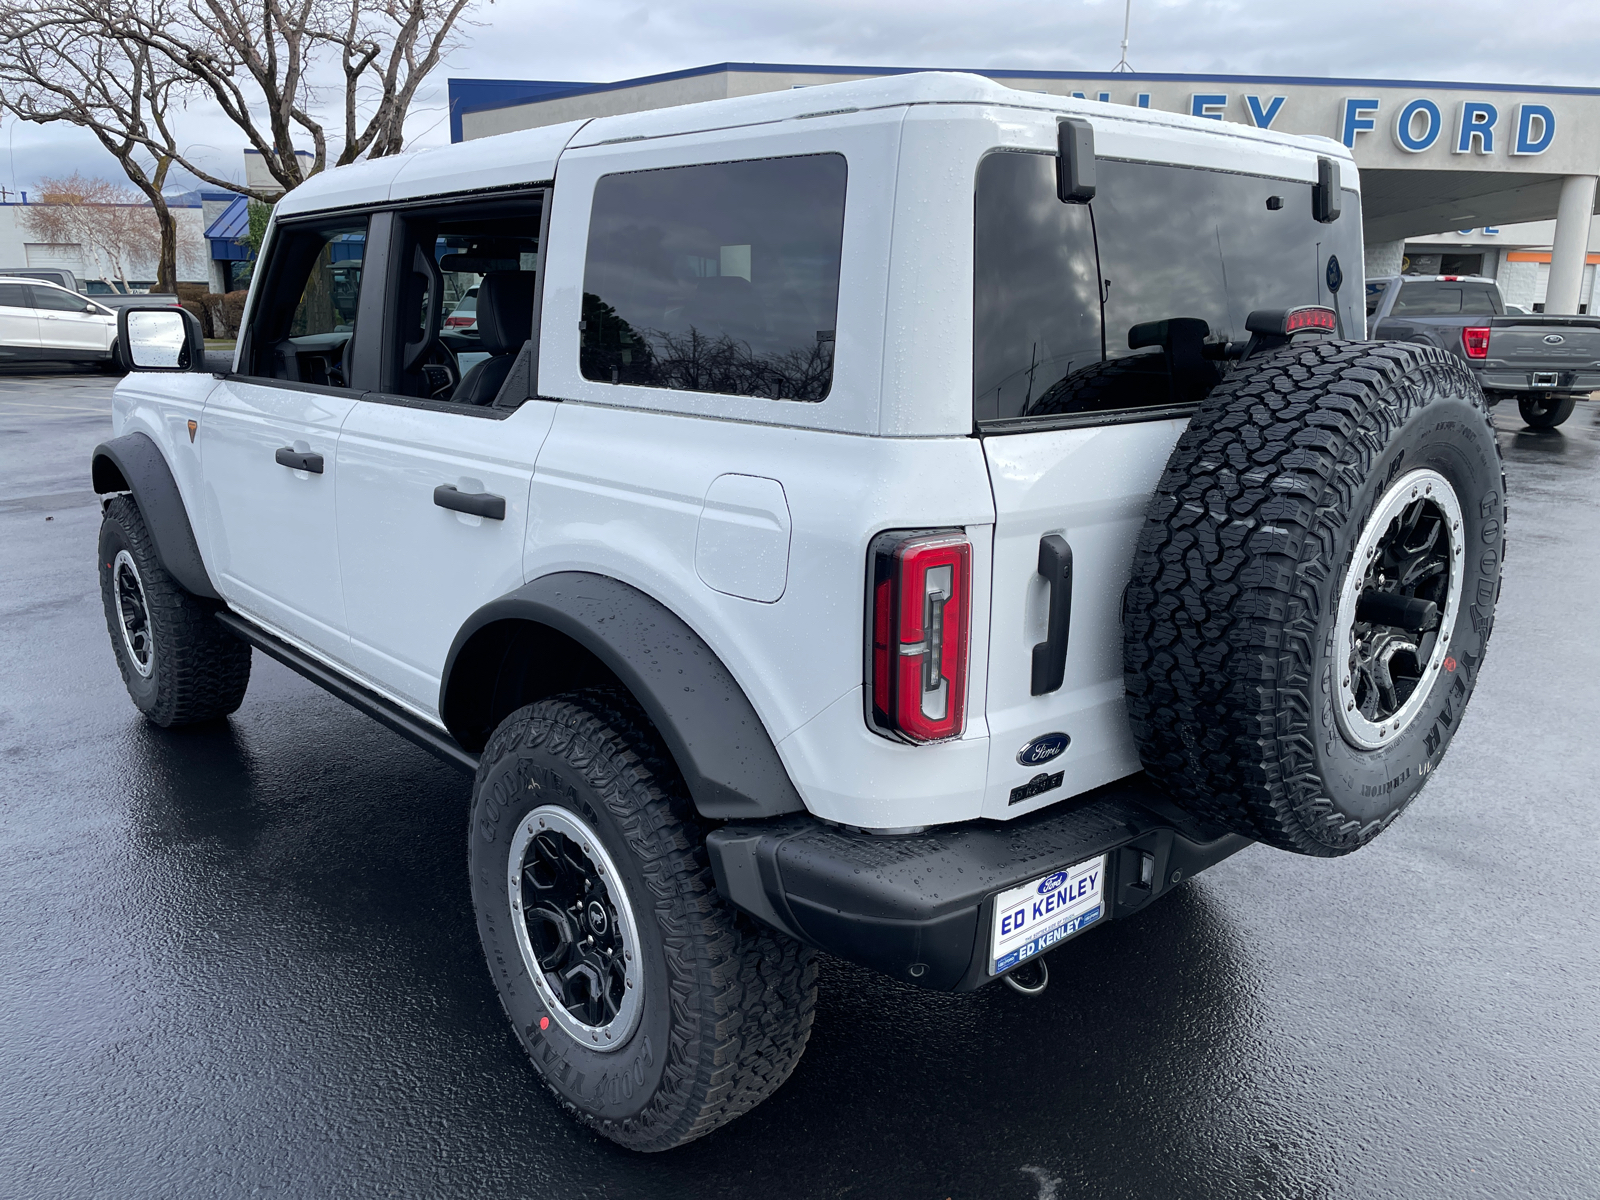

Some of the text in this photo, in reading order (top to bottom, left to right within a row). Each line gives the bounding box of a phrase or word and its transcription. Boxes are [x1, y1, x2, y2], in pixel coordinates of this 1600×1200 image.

[1339, 97, 1557, 156] FORD
[1032, 742, 1061, 761] Ford
[1360, 767, 1411, 797] TERRITORY
[1043, 873, 1065, 892] Ford
[1001, 872, 1098, 935] ED KENLEY
[1019, 918, 1080, 959] ED KENLEY
